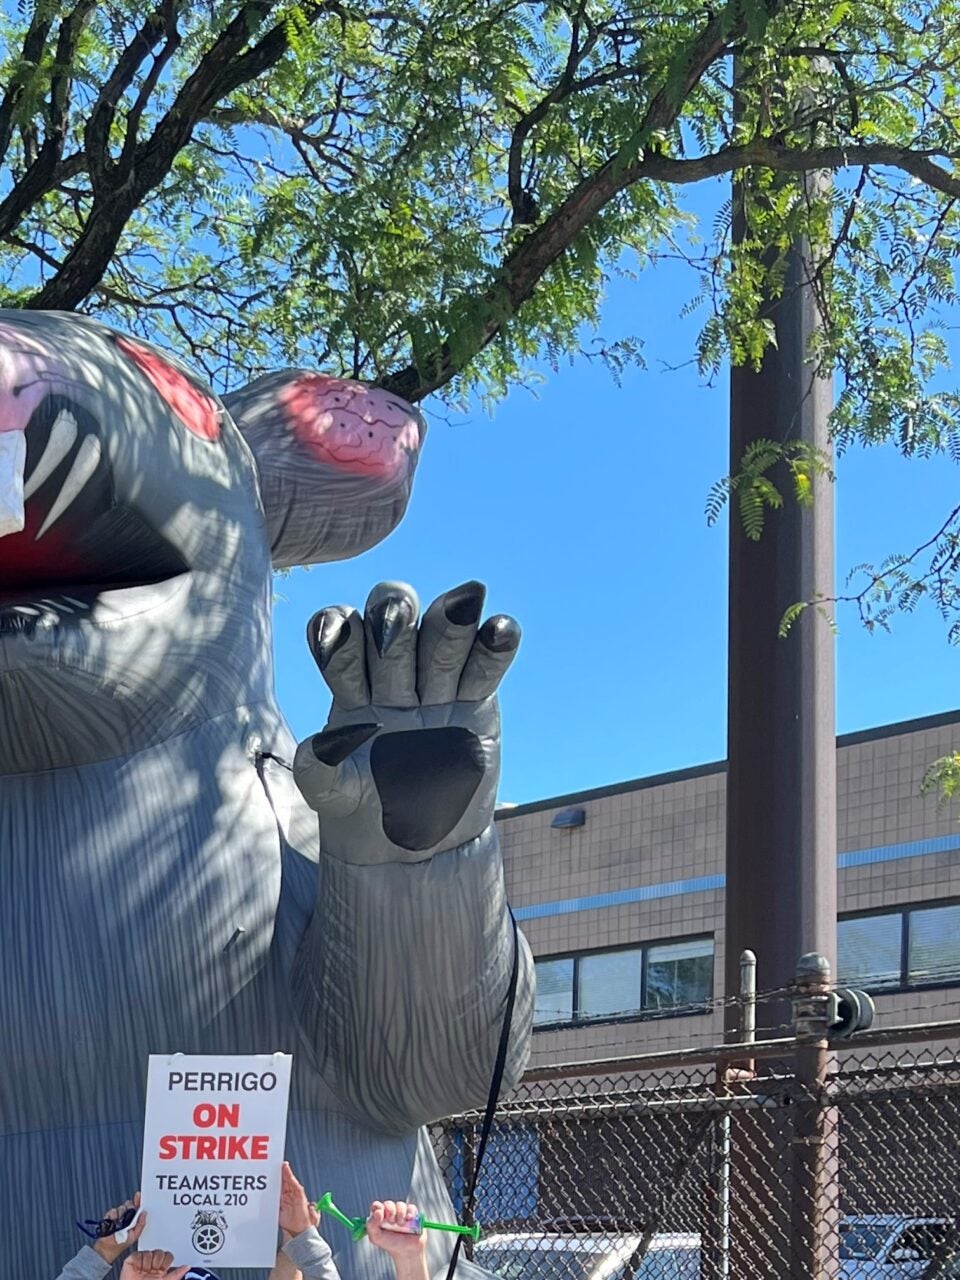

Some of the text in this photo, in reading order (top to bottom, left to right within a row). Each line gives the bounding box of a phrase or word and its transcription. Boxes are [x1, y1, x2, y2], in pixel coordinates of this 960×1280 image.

[168, 1071, 277, 1092] PERRIGO
[192, 1103, 240, 1129] ON
[158, 1135, 270, 1160] STRIKE
[155, 1174, 268, 1191] TEAMSTERS
[173, 1193, 249, 1207] LOCAL 210
